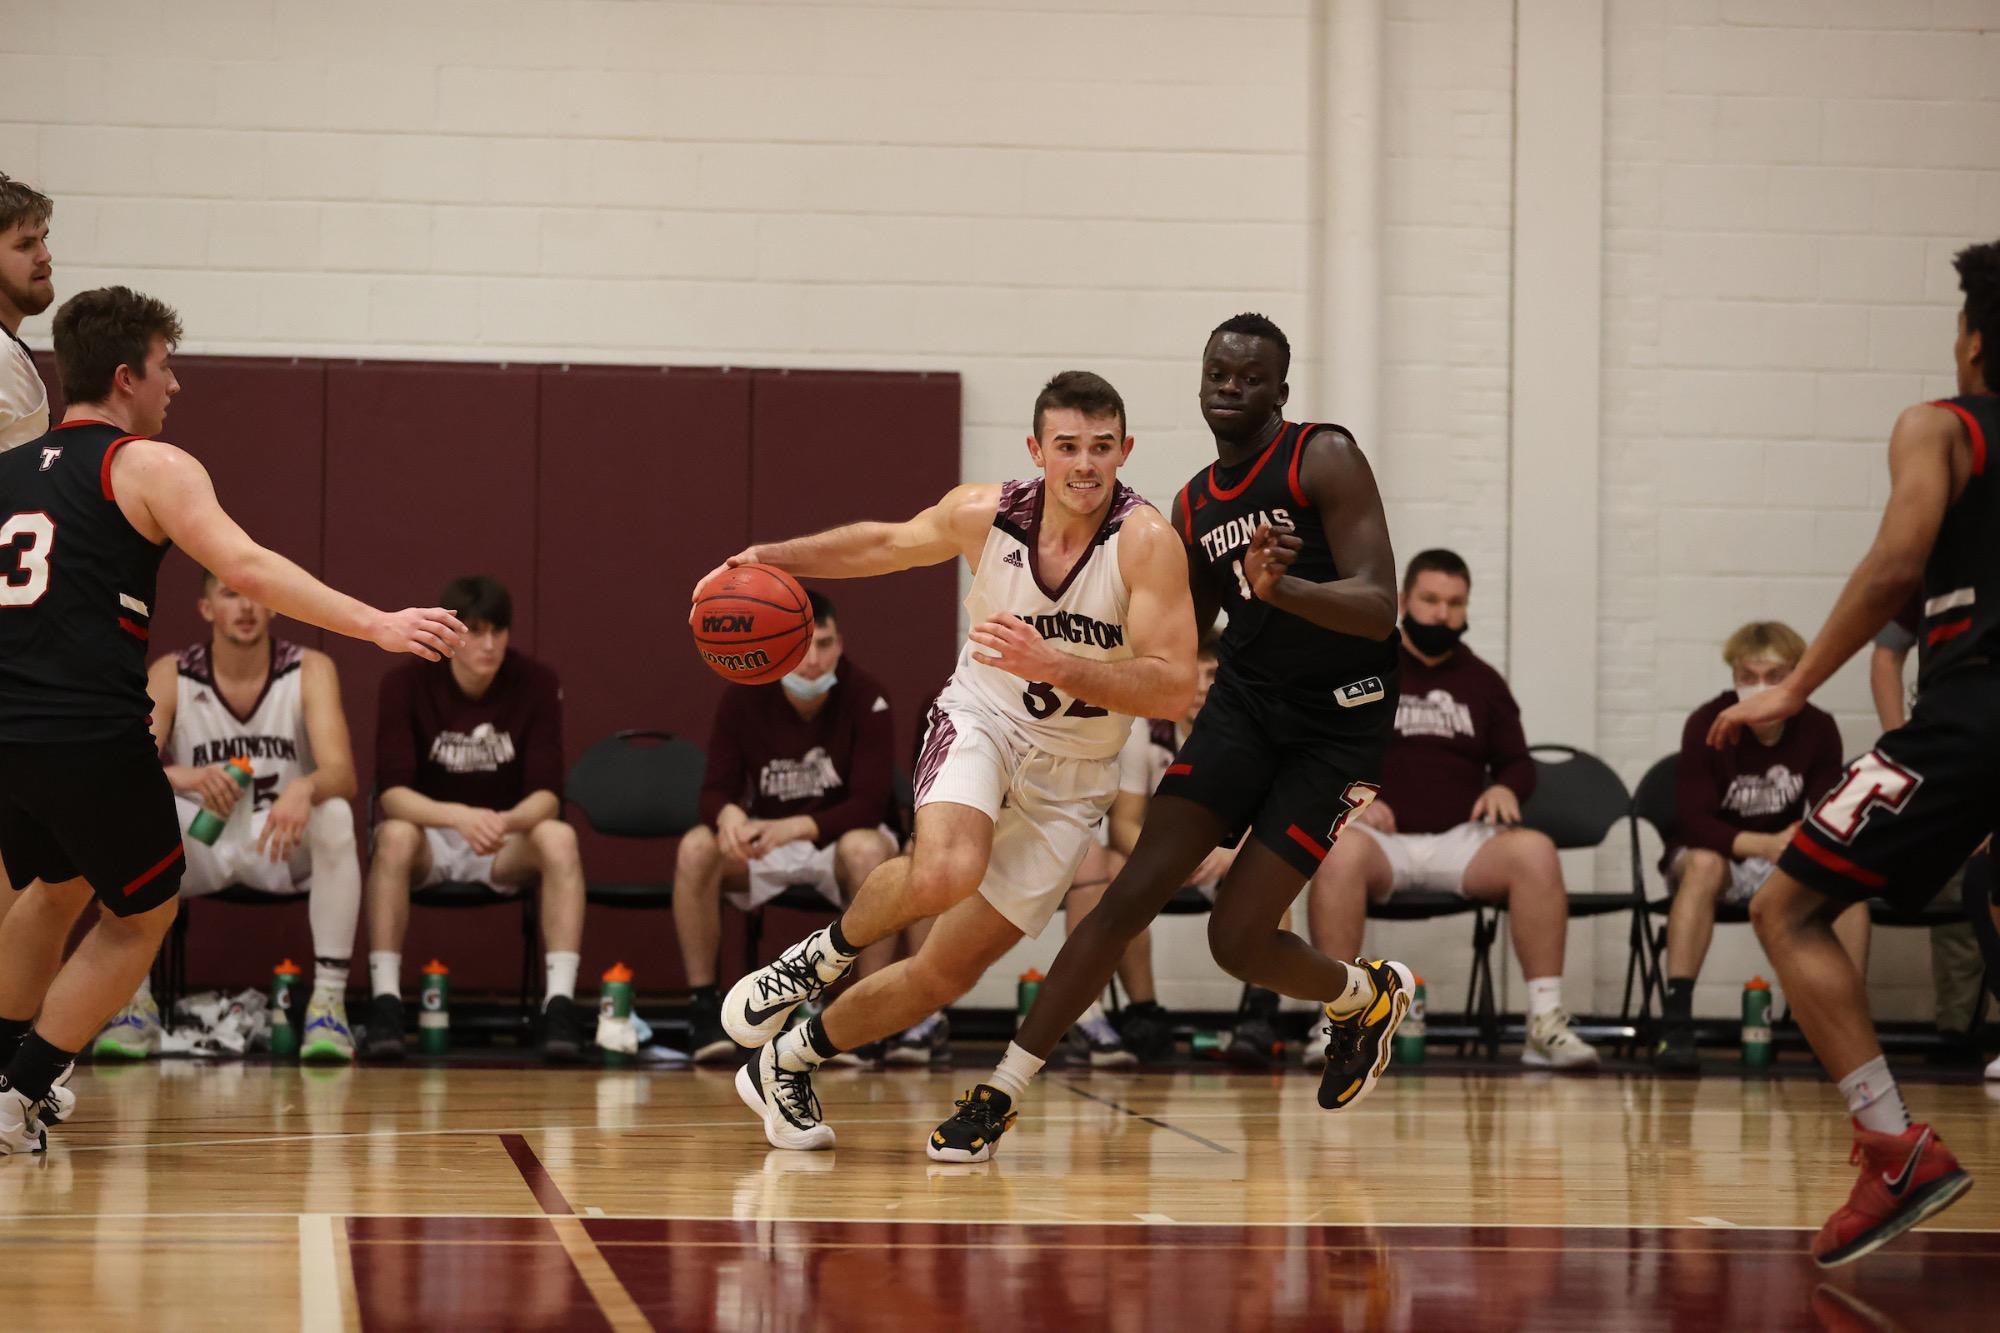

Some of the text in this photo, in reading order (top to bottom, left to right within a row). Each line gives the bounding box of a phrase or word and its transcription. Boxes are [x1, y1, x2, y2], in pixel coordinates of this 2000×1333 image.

[39, 446, 63, 471] T
[0, 511, 57, 608] 3
[703, 614, 755, 633] NCAA
[1808, 750, 1923, 846] T
